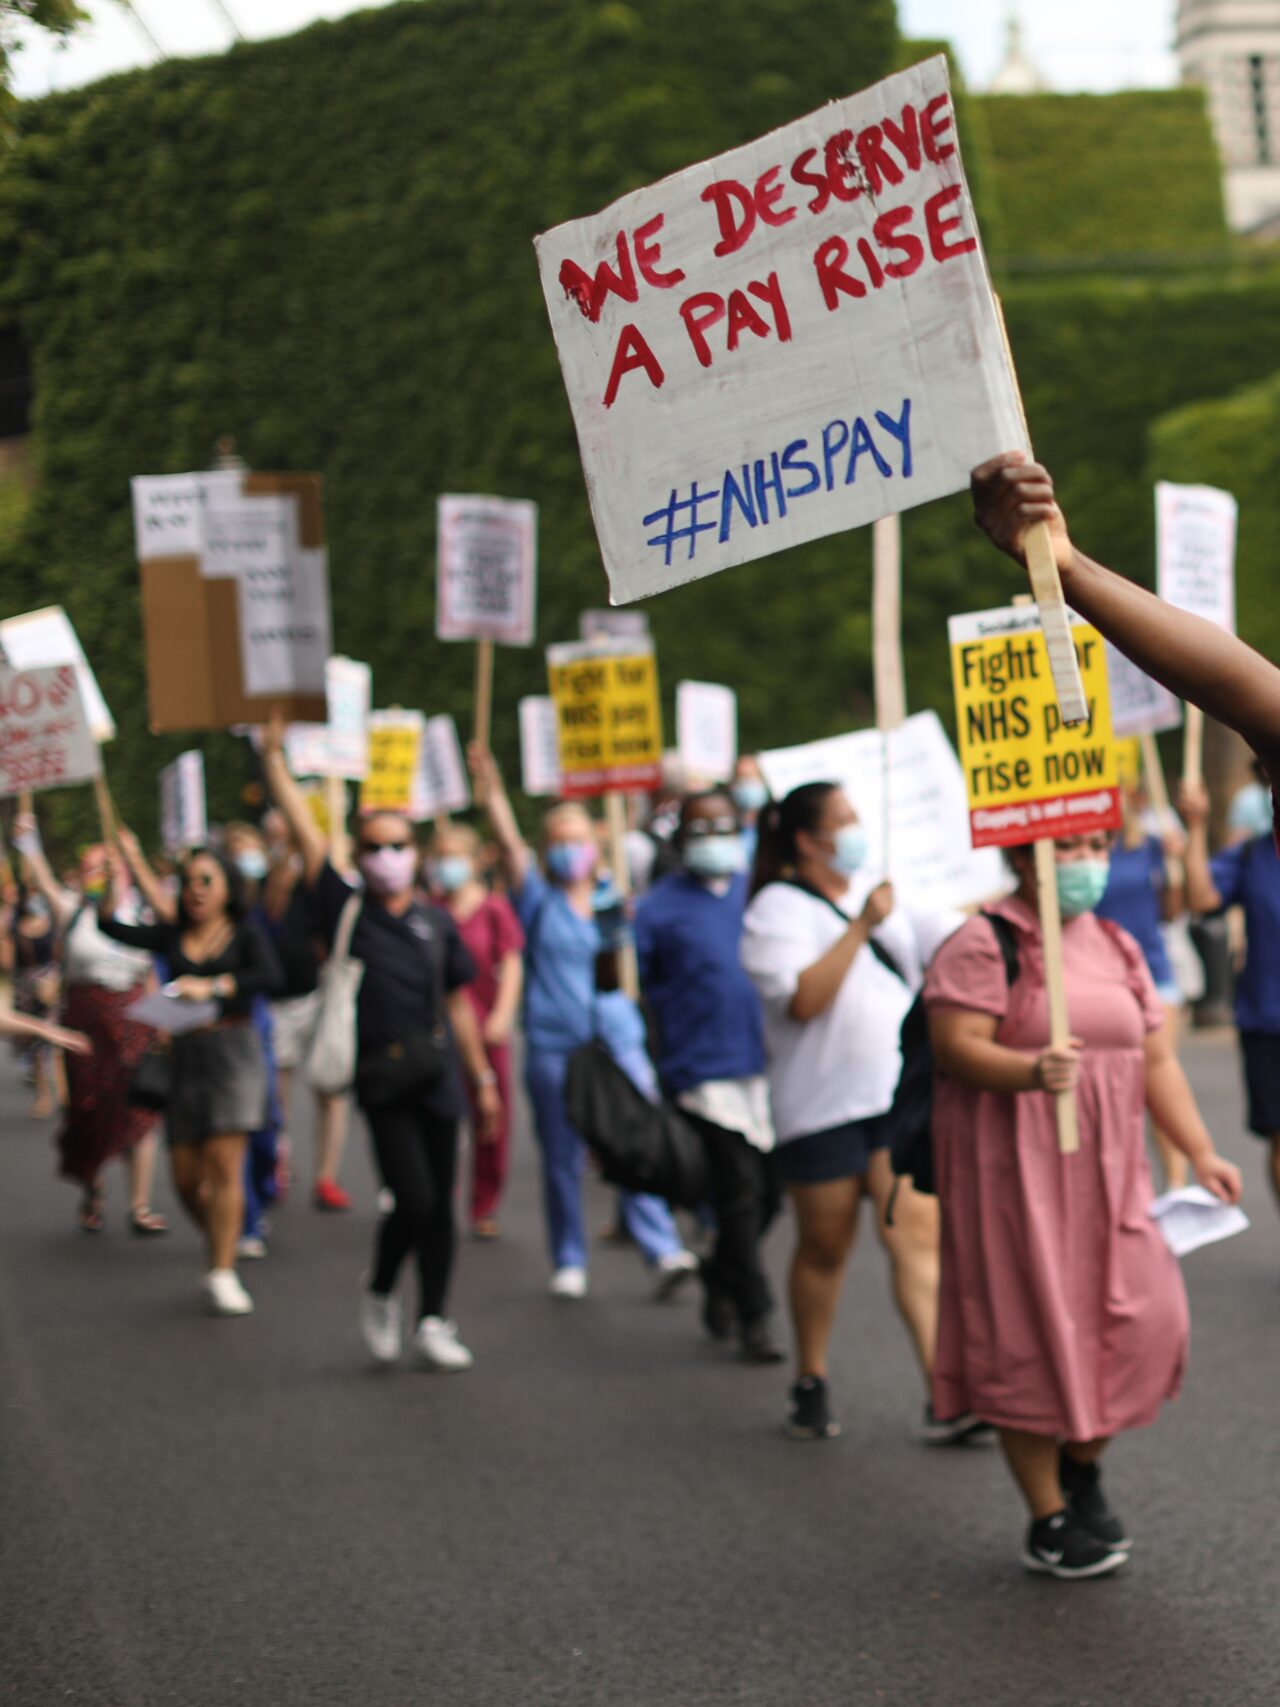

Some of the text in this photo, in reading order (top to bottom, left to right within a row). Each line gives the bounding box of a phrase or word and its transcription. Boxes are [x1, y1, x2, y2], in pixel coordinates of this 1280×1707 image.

[559, 93, 954, 323] WE DESERVE
[602, 184, 977, 408] A PAY RISE
[643, 398, 913, 566] #NHSPAY
[961, 638, 1040, 694] Fight
[966, 696, 1097, 745] NHS py
[971, 746, 1106, 796] rise now
